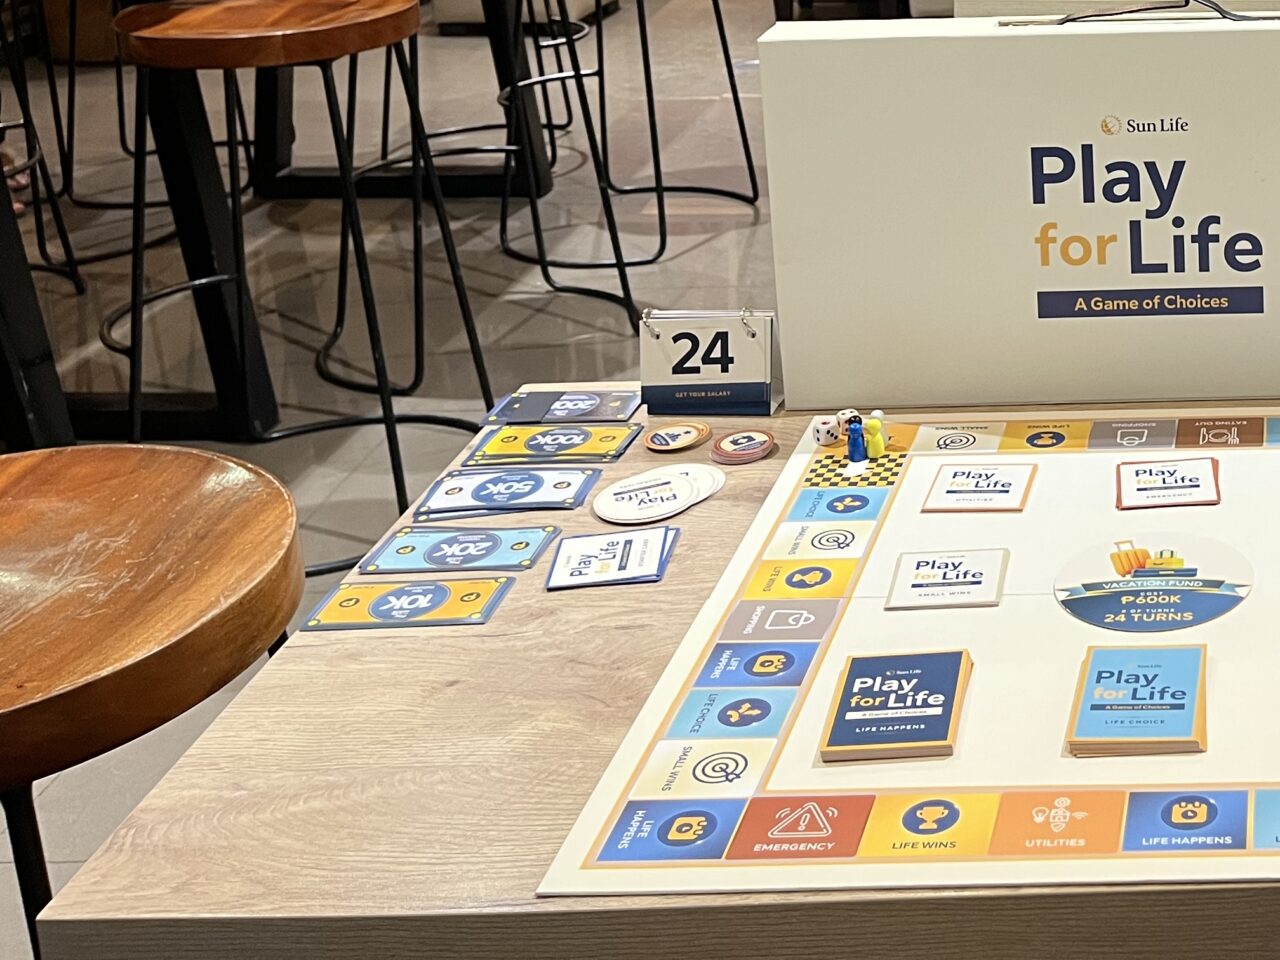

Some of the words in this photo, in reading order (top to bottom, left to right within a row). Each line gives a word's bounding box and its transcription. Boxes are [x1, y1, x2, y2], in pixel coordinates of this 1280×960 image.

[1126, 119, 1156, 133] Sun
[1160, 118, 1189, 132] Life
[1030, 143, 1186, 219] Play
[1034, 222, 1118, 266] for
[1129, 215, 1264, 274] Life
[1074, 297, 1088, 311] A
[1090, 296, 1139, 311] Game
[1142, 294, 1161, 310] of
[1164, 294, 1229, 309] Choices
[671, 331, 734, 375] 24
[529, 434, 587, 445] 100K
[952, 470, 996, 482] Play
[1135, 468, 1178, 478] Play
[1162, 476, 1200, 485] Life
[480, 480, 536, 496] 50K
[974, 480, 1012, 488] Life
[638, 493, 678, 506] Play
[433, 542, 493, 557] 20K
[598, 540, 620, 561] Life
[569, 554, 598, 576] Play
[915, 560, 964, 572] Play
[942, 570, 984, 580] Life
[1102, 580, 1168, 589] VACATION
[379, 593, 434, 610] 10K
[744, 605, 766, 635] SHOPPING
[1104, 614, 1126, 622] 24
[1131, 612, 1194, 622] TURNS
[710, 650, 733, 679] HAPPENS
[726, 658, 741, 670] LIFE
[852, 676, 919, 694] Play
[1095, 670, 1160, 688] Play
[704, 693, 718, 708] LIFE
[850, 695, 886, 708] for
[887, 690, 946, 708] Life
[1094, 687, 1128, 700] for
[1130, 686, 1187, 701] Life
[690, 708, 710, 734] CHOICE
[674, 746, 694, 770] SMALL
[661, 770, 679, 792] WINS
[618, 810, 647, 849] HAPPENS
[641, 820, 654, 838] LIFE
[753, 842, 836, 852] EMERGENCY
[892, 841, 920, 850] LIFE
[922, 840, 956, 850] WINS
[1025, 838, 1086, 848] UTILITIES
[1142, 836, 1169, 846] LIFE
[1170, 835, 1232, 846] HAPPENS
